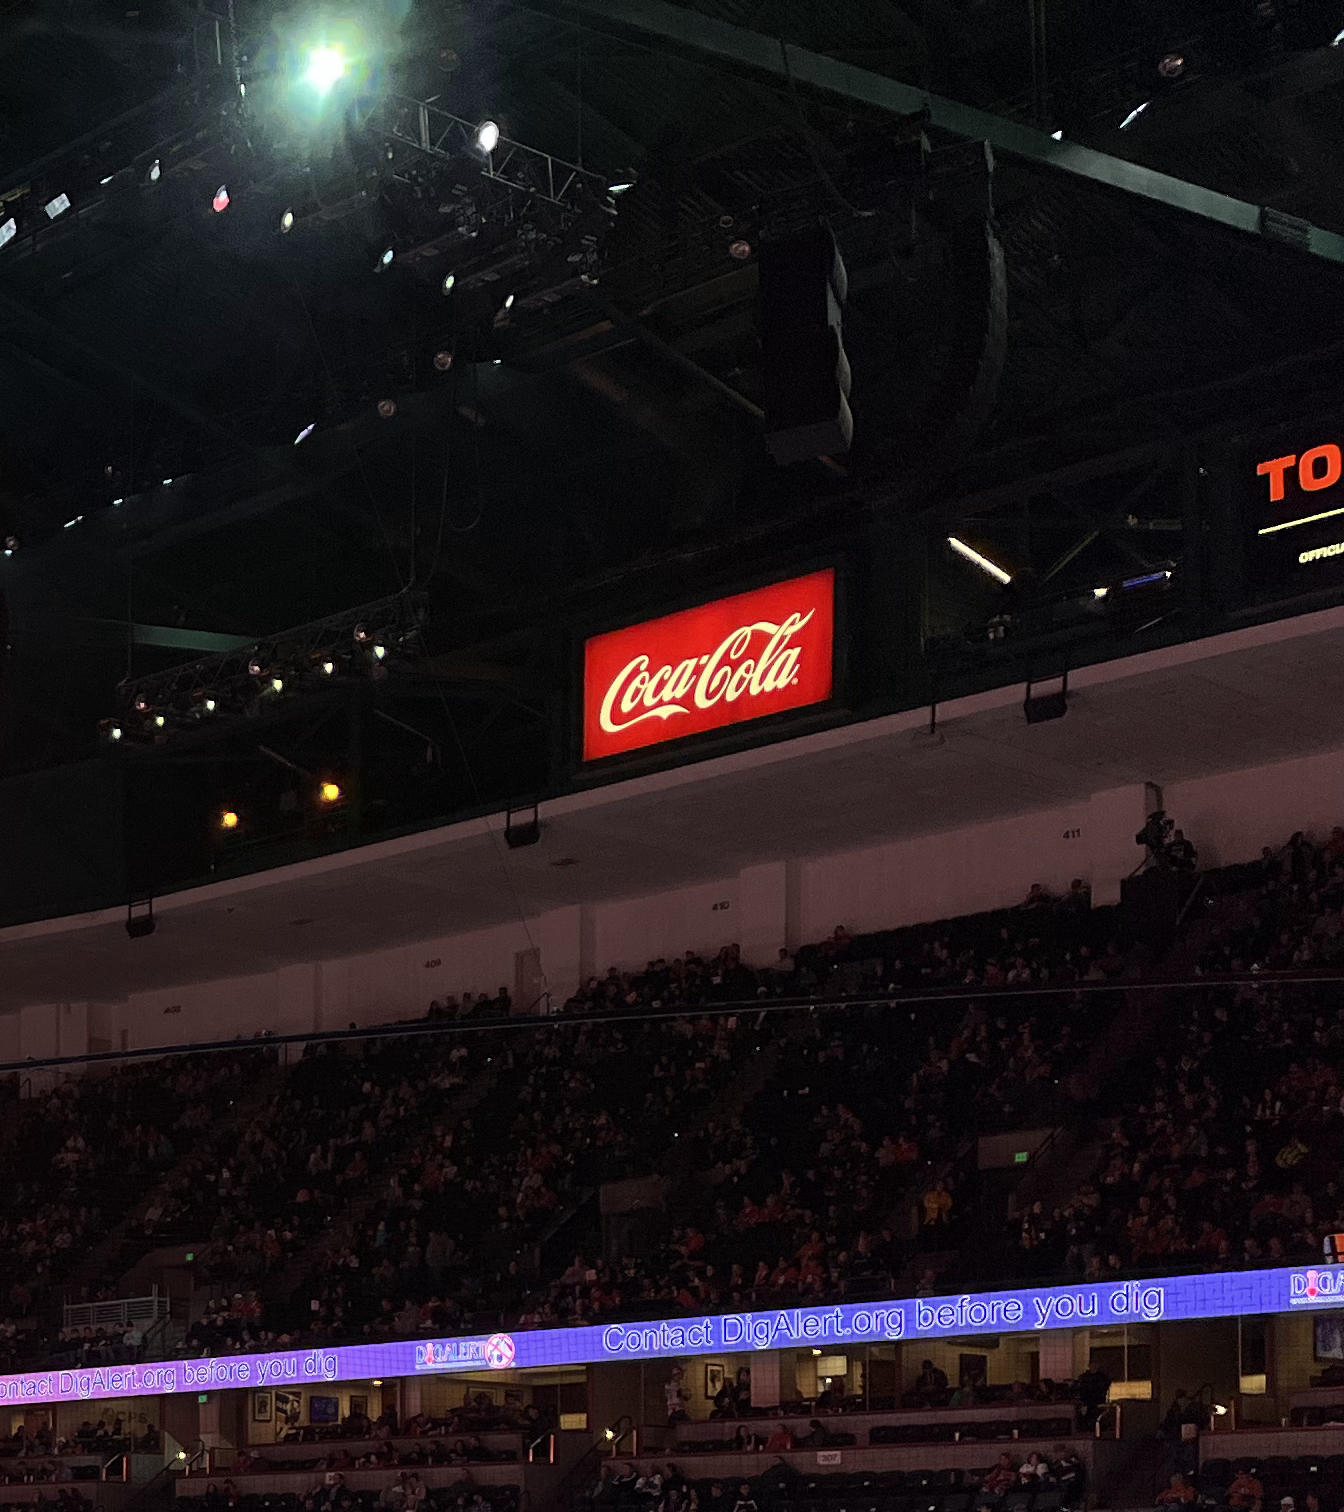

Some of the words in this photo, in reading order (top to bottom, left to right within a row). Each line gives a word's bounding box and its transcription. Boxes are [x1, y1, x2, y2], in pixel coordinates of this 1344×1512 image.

[1256, 443, 1343, 503] TO
[599, 607, 817, 733] Coca-Cola
[1062, 828, 1081, 839] 411
[602, 1319, 714, 1355] Contact
[721, 1306, 906, 1350] DigAlert.org
[915, 1294, 1023, 1330] before
[1034, 1291, 1098, 1329] you
[1110, 1280, 1165, 1320] dig
[58, 1365, 176, 1400] DigAlert.org
[183, 1358, 250, 1385] before
[257, 1356, 298, 1383] you
[304, 1350, 339, 1381] dig
